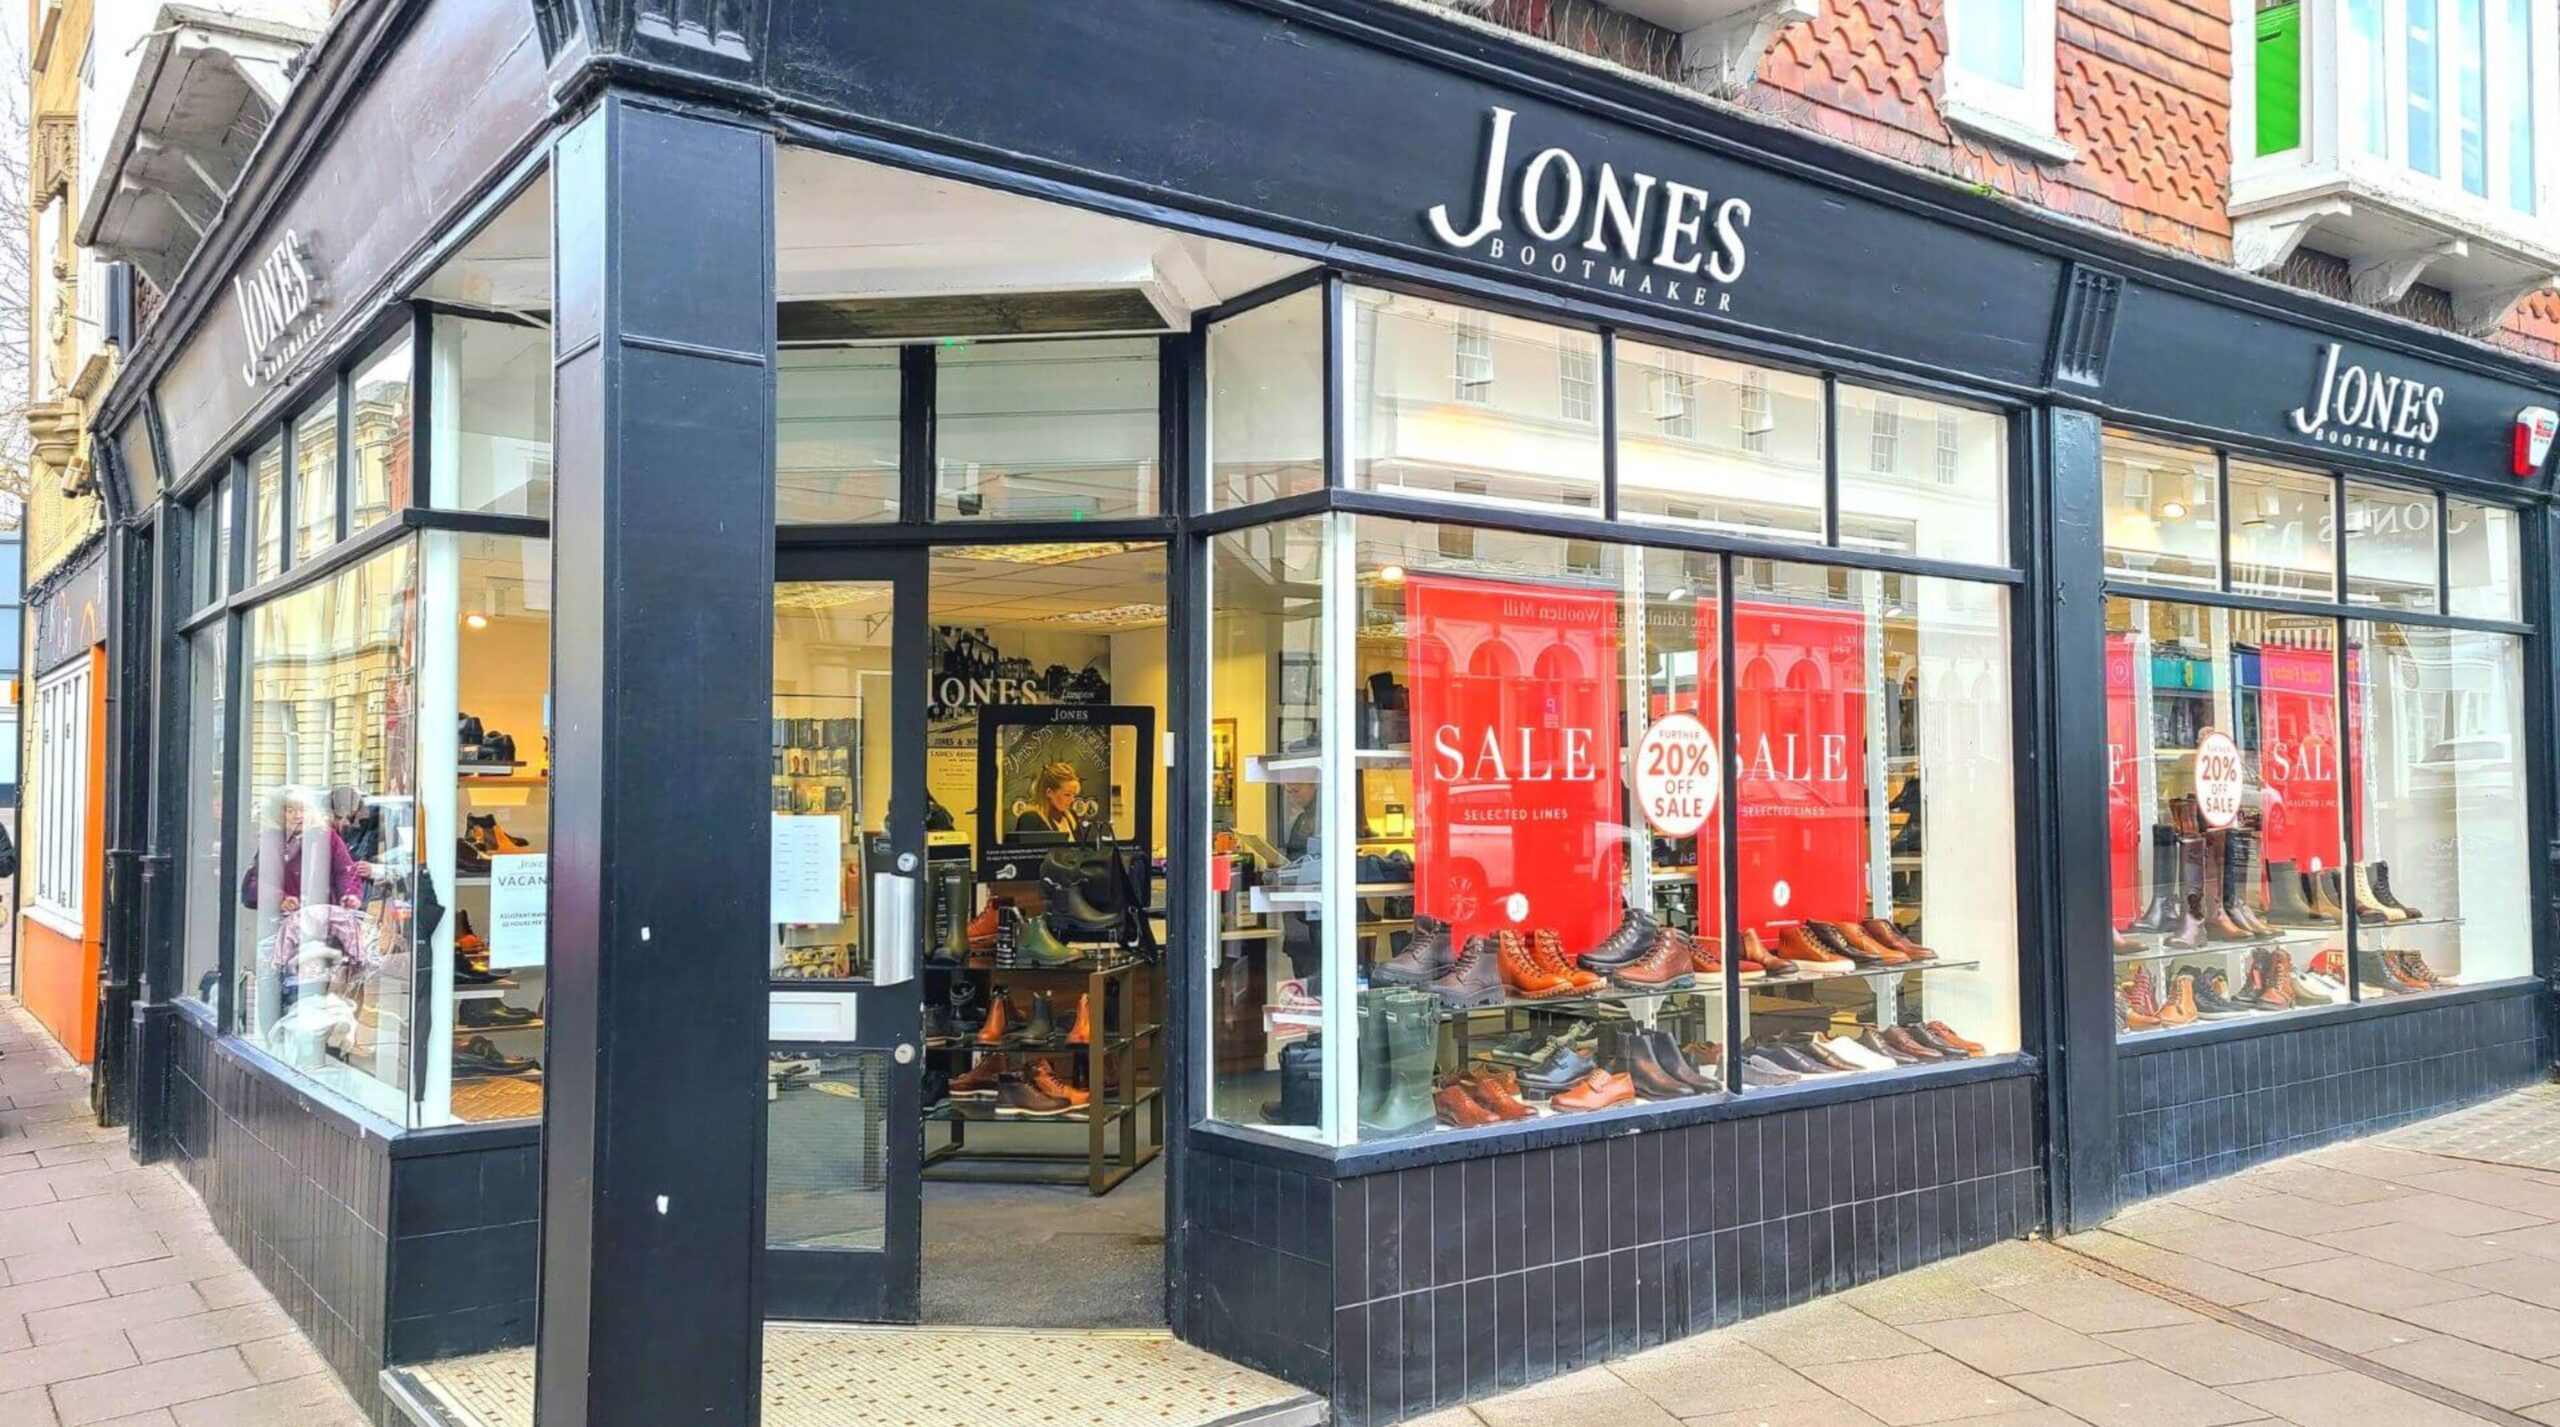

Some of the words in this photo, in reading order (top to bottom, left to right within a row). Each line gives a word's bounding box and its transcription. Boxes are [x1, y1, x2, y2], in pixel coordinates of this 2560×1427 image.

[1429, 106, 1752, 283] JONES
[1489, 237, 1731, 312] BOOTMAKER
[233, 229, 309, 387] JONES
[2296, 343, 2444, 443] JONES
[2315, 428, 2427, 461] BOOTMAKER
[1051, 708, 1089, 722] JONES
[1659, 730, 1700, 739] FURTHER
[1434, 724, 1596, 782] SALE
[1648, 742, 1710, 777] 20%
[2272, 742, 2332, 782] SAL
[2202, 755, 2237, 782] 20%
[1665, 779, 1695, 795] OFF
[2211, 783, 2228, 796] OFF
[1464, 809, 1528, 821] SELECTED
[1532, 808, 1568, 820] LINES
[1655, 797, 1704, 818] SALE
[2206, 797, 2234, 813] SALE
[517, 860, 544, 870] JONE
[498, 876, 547, 887] VACAN
